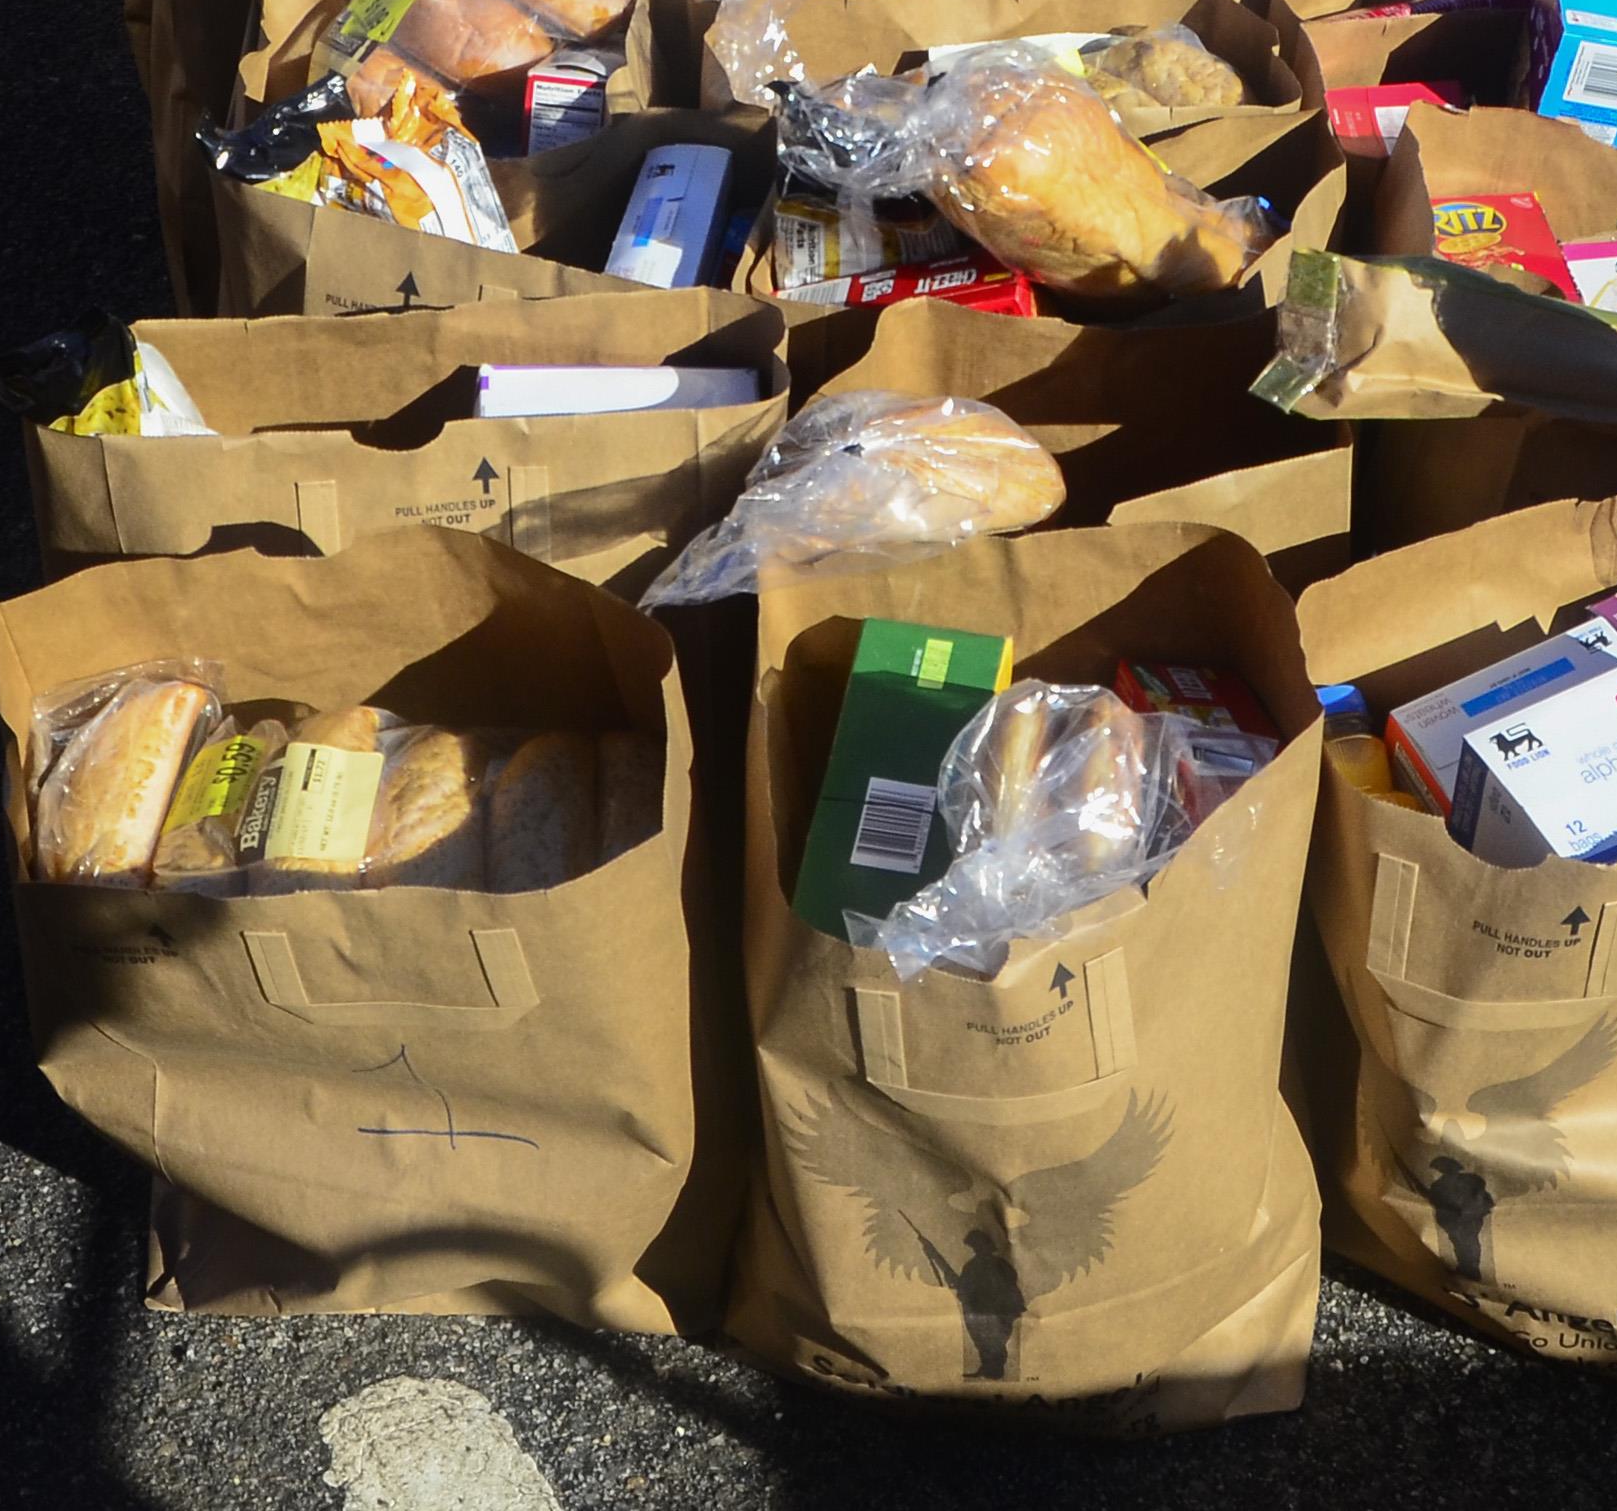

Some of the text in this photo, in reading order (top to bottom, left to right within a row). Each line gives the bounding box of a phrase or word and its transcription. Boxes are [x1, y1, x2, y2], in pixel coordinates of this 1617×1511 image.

[449, 158, 465, 179] 140
[1433, 205, 1503, 232] RITZ
[325, 294, 349, 309] PULL
[394, 498, 496, 518] PULL HANDLES UP
[445, 514, 471, 525] OUT
[212, 742, 256, 785] $0.59
[1506, 748, 1552, 772] FOOD LION
[1575, 742, 1613, 766] whole
[239, 775, 278, 852] Bakery
[1565, 819, 1589, 836] 12
[1567, 831, 1603, 853] bags
[1472, 919, 1582, 948] PULL HANDLES UP
[1496, 943, 1553, 959] NOT OUT
[966, 999, 1075, 1036] PULL HANDLES UP
[994, 1026, 1052, 1046] NOT OUT
